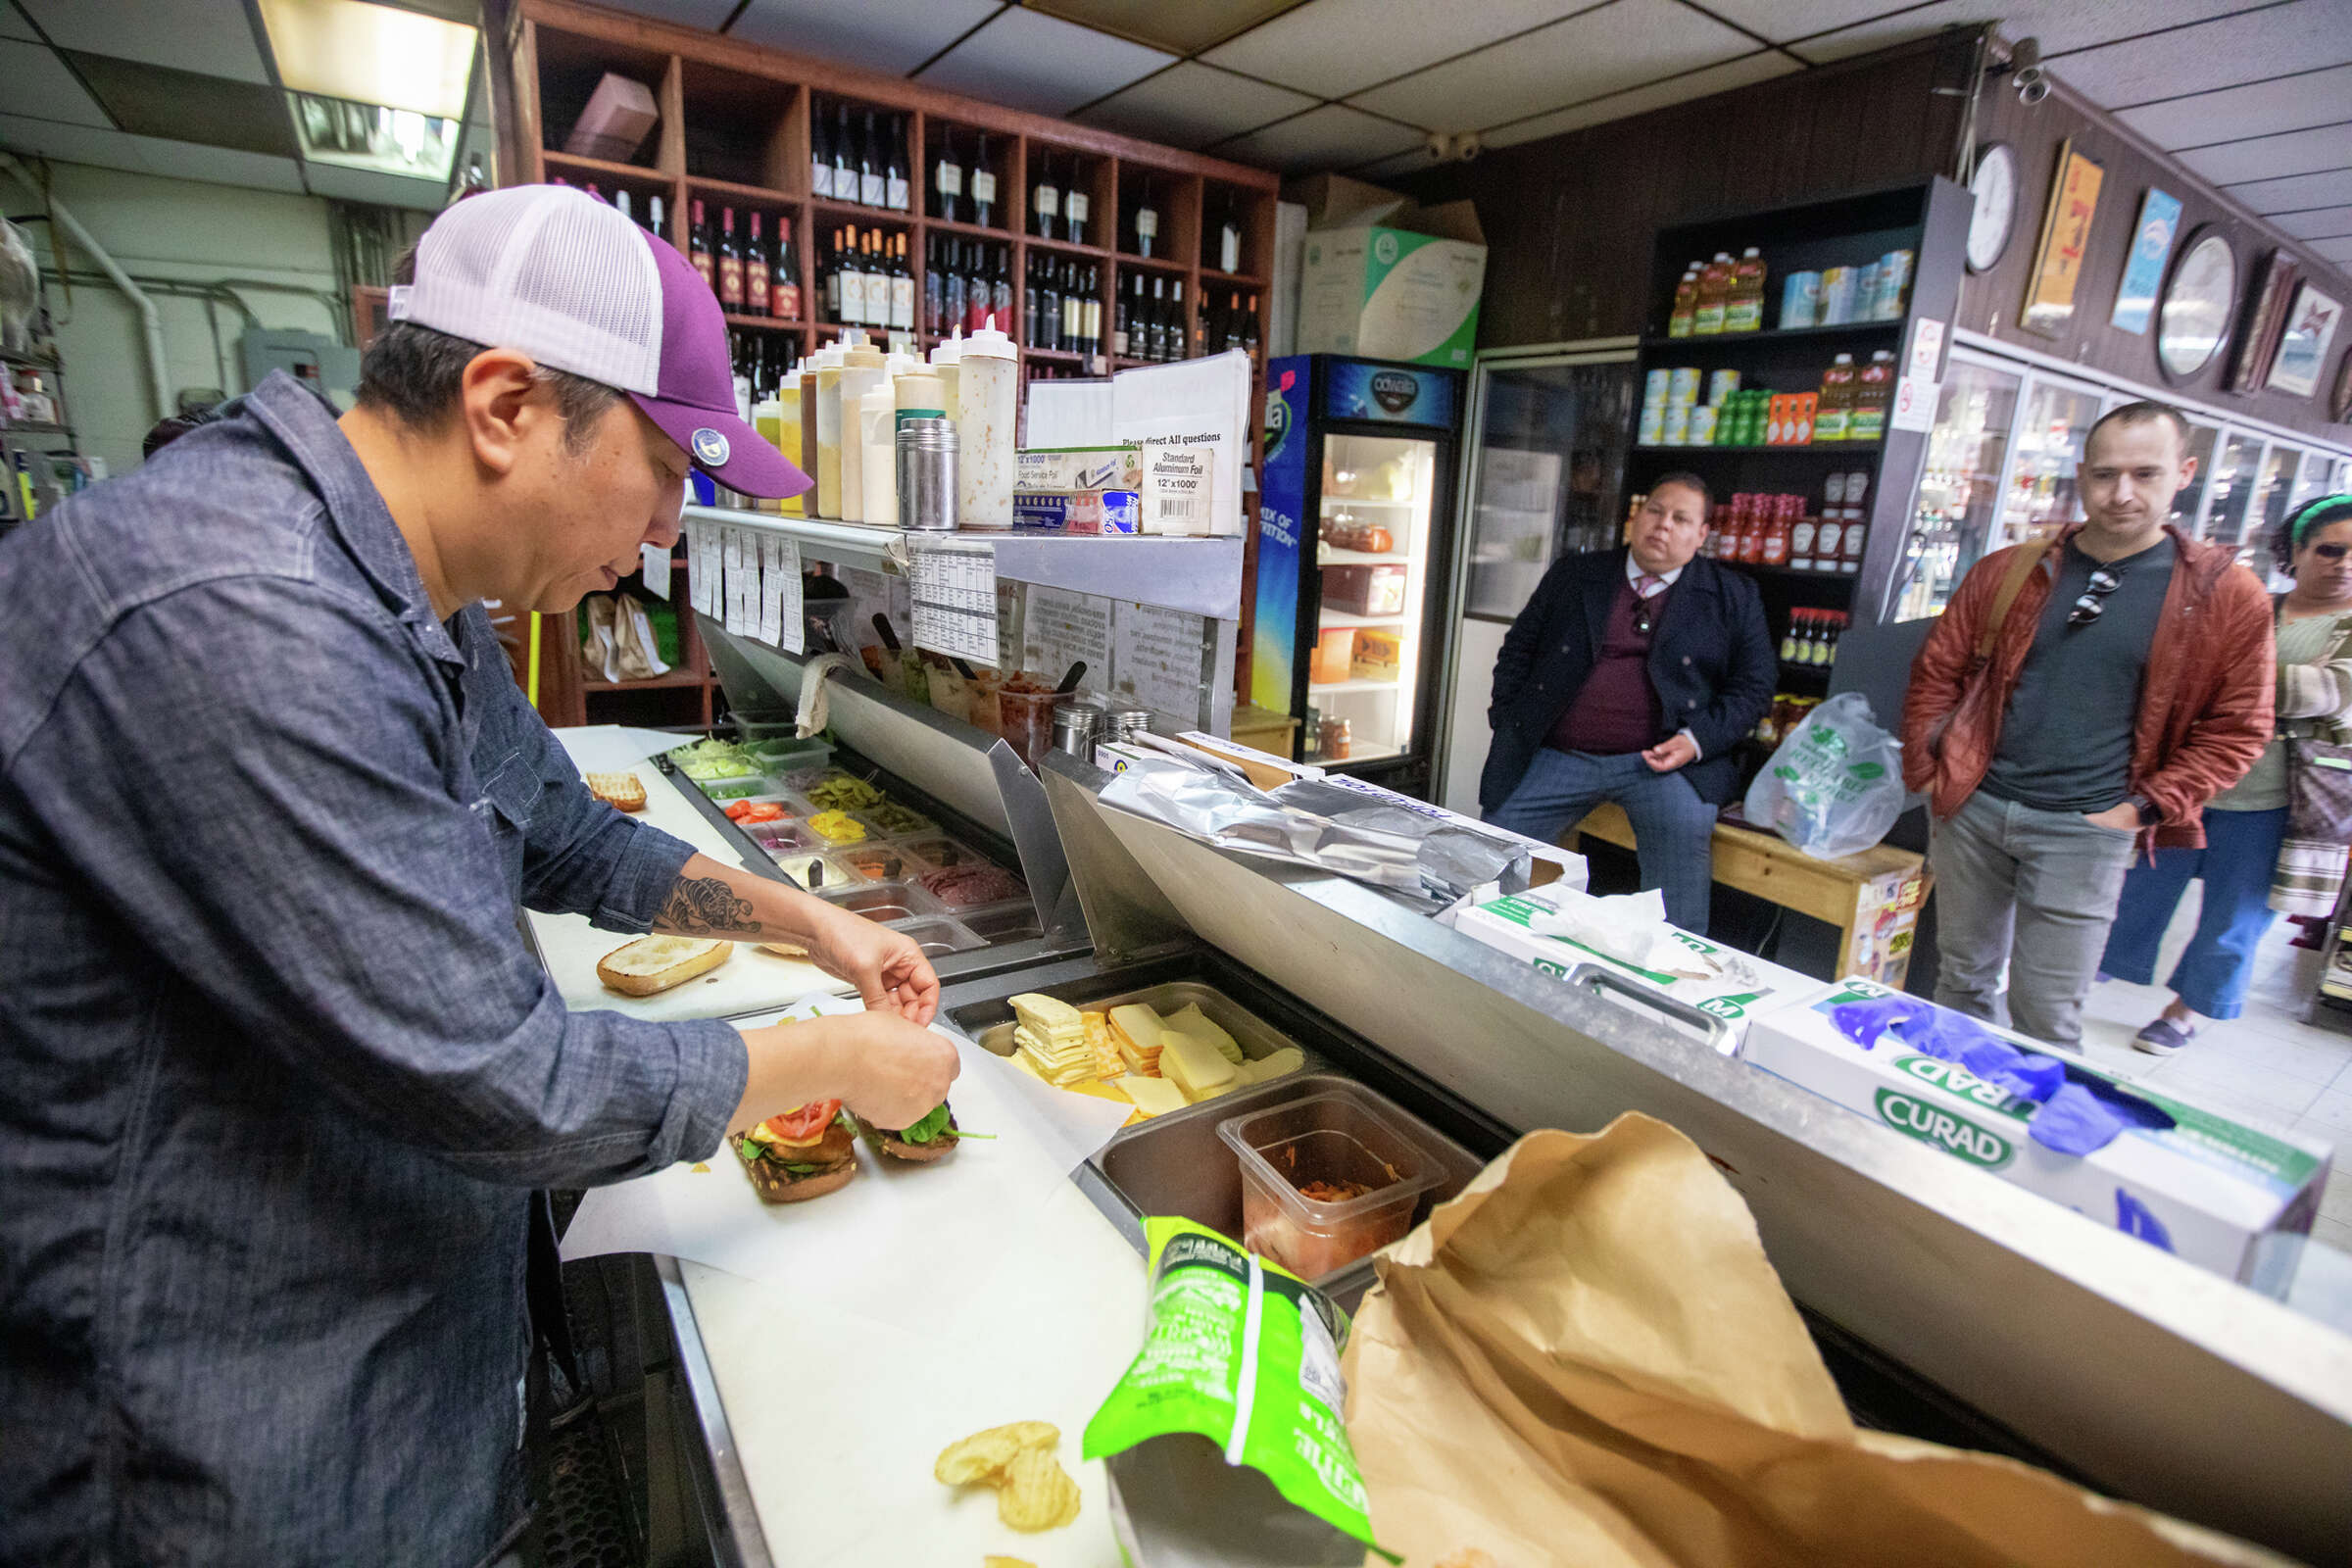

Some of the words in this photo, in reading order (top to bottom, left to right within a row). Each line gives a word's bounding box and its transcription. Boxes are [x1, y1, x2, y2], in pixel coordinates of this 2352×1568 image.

[1123, 438, 1144, 447] Please
[1168, 434, 1181, 445] All
[1182, 432, 1221, 446] questions
[1161, 452, 1196, 464] Standard
[1152, 462, 1190, 474] Aluminum
[1190, 465, 1203, 475] Foil
[1703, 1000, 1740, 1017] M
[1883, 1095, 2002, 1162] CURAD
